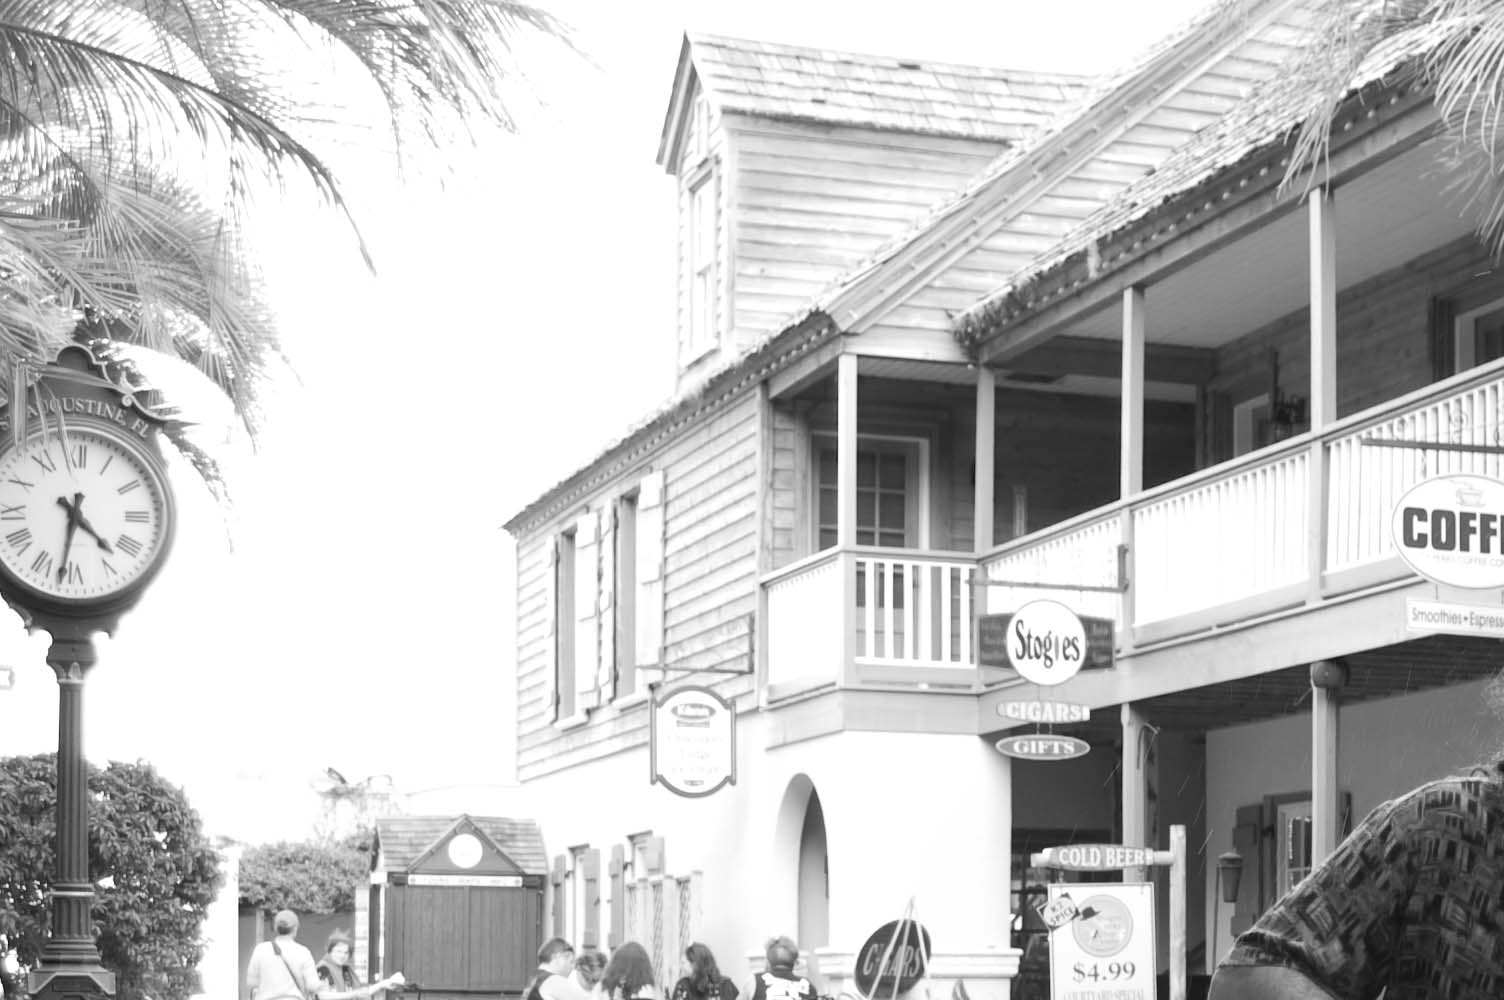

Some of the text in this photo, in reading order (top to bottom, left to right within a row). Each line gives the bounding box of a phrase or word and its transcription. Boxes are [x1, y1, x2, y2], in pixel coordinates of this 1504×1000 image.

[131, 418, 150, 438] FL
[1412, 607, 1463, 625] Smoothies
[1015, 619, 1080, 669] Stogies
[1006, 701, 1082, 722] CIGARS
[1013, 740, 1075, 755] GIFTS
[1058, 847, 1145, 867] COLD BEER
[863, 943, 921, 977] CIARS
[1073, 961, 1136, 983] $4.99
